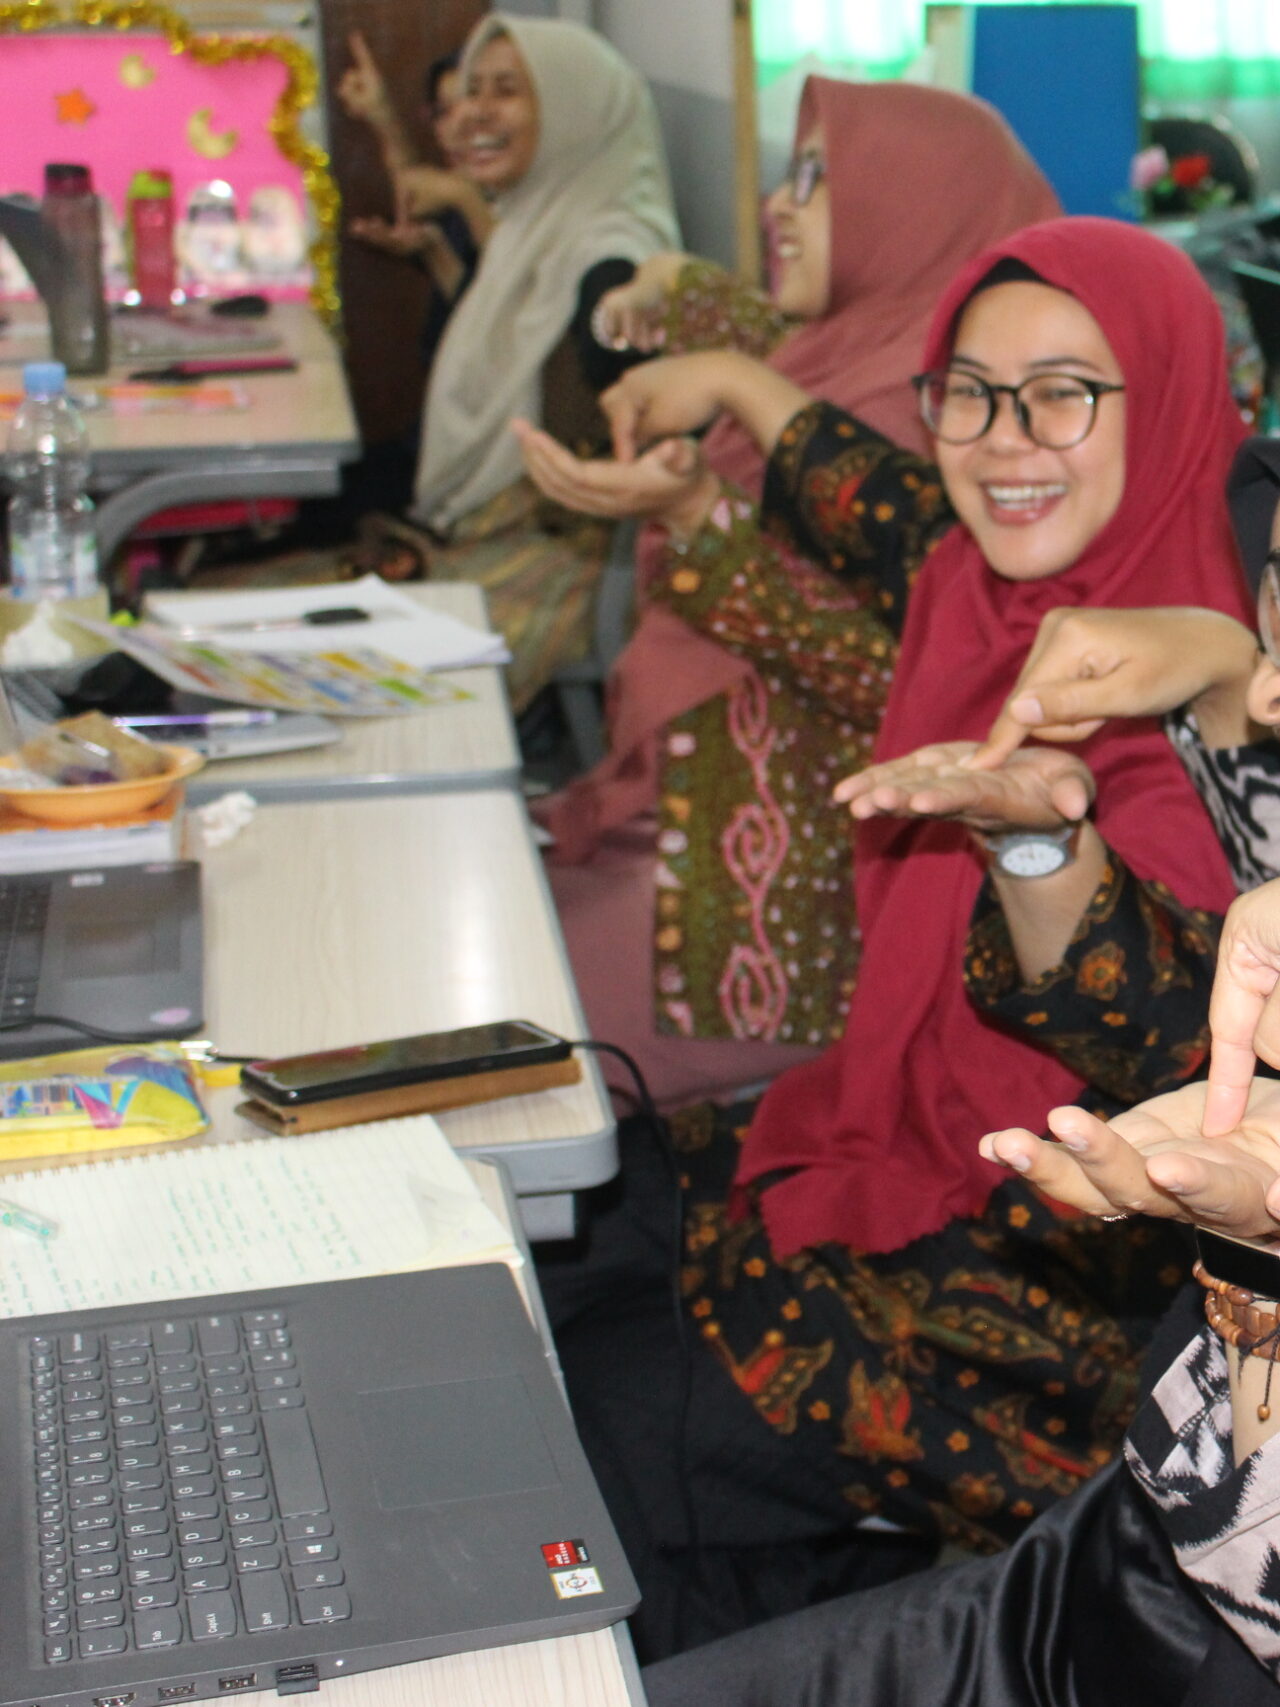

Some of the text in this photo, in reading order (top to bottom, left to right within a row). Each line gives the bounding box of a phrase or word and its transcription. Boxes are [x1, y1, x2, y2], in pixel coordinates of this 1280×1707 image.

[167, 1403, 182, 1411] L
[119, 1415, 134, 1423] O
[219, 1425, 235, 1434] M
[223, 1447, 238, 1455] N
[123, 1458, 138, 1466] U
[175, 1465, 191, 1473] H
[178, 1486, 193, 1494] G
[230, 1491, 246, 1499] V
[234, 1512, 250, 1520] C
[130, 1524, 146, 1533] R
[184, 1532, 200, 1540] D
[238, 1535, 254, 1544] X
[133, 1548, 148, 1556] E
[187, 1556, 203, 1564] S
[135, 1570, 151, 1580] W
[315, 1574, 326, 1582] Fn
[191, 1579, 207, 1587] A
[81, 1591, 95, 1599] @
[138, 1595, 154, 1604] Q
[322, 1605, 333, 1616] Ctrl
[261, 1612, 273, 1625] Shift
[206, 1613, 219, 1633] CapsLk
[152, 1630, 162, 1641] Tab
